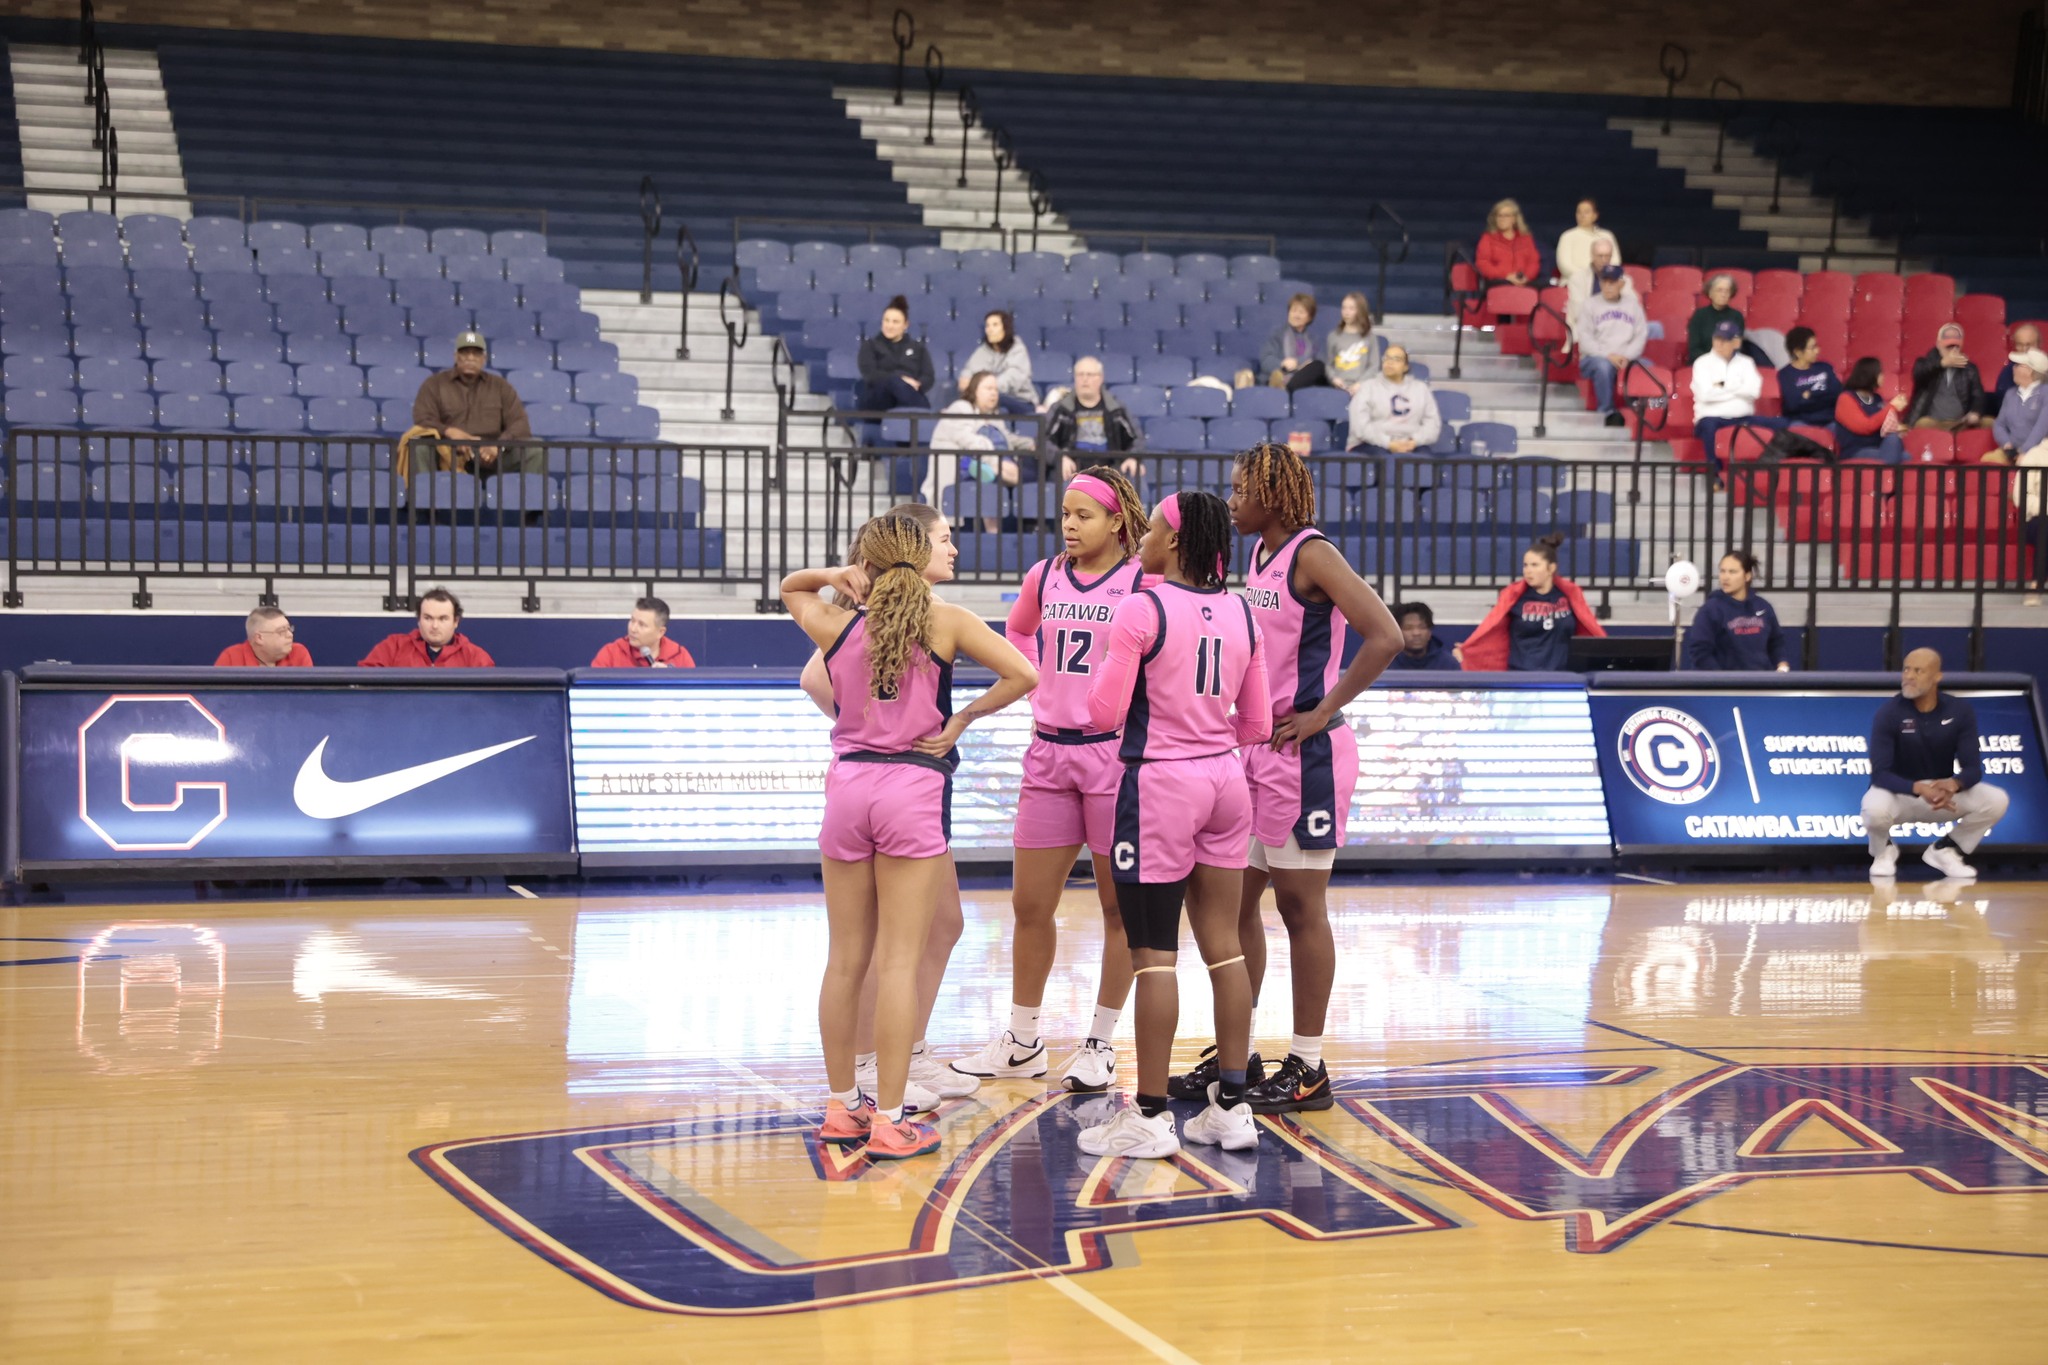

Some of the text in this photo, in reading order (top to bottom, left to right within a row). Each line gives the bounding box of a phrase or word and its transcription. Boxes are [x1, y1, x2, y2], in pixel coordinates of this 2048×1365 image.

[1391, 395, 1411, 416] C
[1109, 588, 1124, 596] SAC
[1246, 586, 1281, 611] AWBA
[1201, 606, 1213, 622] C
[1055, 627, 1094, 676] 12
[1195, 635, 1224, 698] 11
[1648, 734, 1690, 776] C
[1763, 734, 2024, 752] SUPPORTING LEGE
[78, 694, 228, 851] C
[1768, 757, 1873, 775] STUDENT-AT
[1982, 757, 2025, 775] 1976
[619, 772, 658, 794] LIVE
[664, 771, 723, 794] STEAM
[731, 770, 791, 791] MODEL
[797, 769, 826, 790] TRA
[1307, 810, 1333, 838] C
[1114, 840, 1136, 871] C
